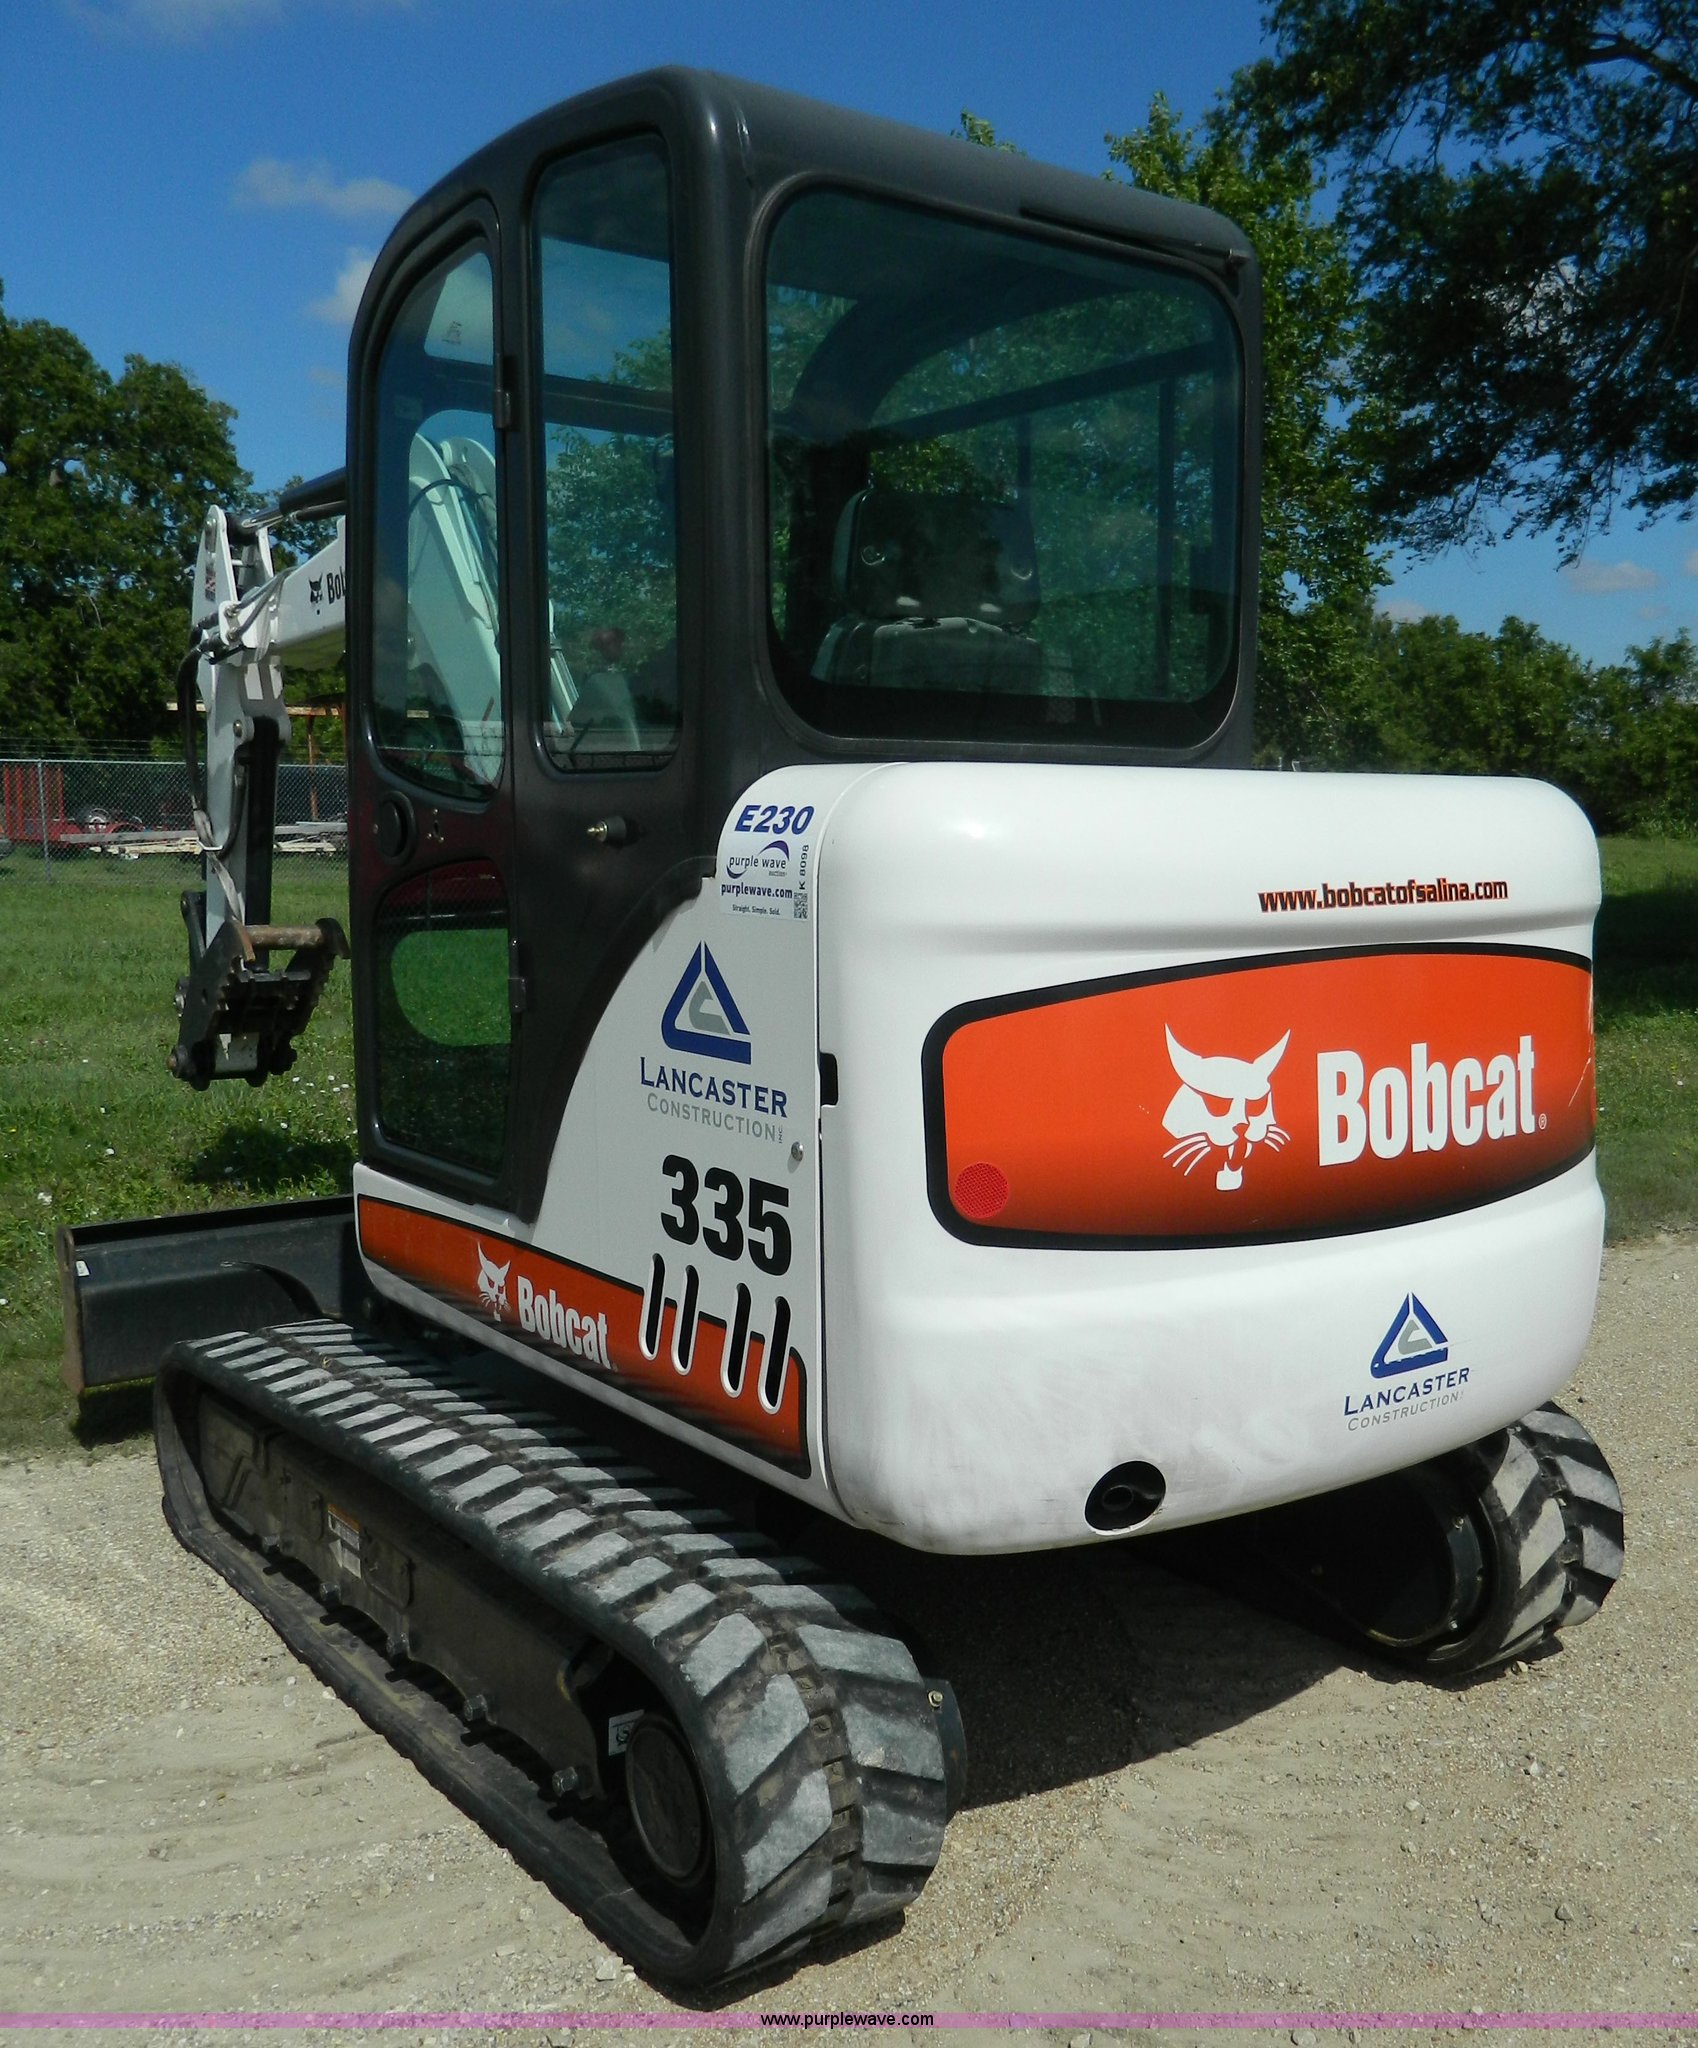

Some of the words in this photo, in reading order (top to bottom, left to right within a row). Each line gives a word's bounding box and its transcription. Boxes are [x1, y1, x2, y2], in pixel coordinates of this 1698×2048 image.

[735, 805, 814, 834] E230
[729, 855, 759, 869] purple
[762, 859, 786, 869] wave
[721, 881, 793, 899] purplewave.com
[1258, 877, 1508, 913] www.bobcatofsalina.com
[640, 1056, 788, 1118] LANCASTER
[1316, 1034, 1536, 1167] Bobcat
[647, 1092, 776, 1142] CONSTRUCTION
[660, 1154, 792, 1276] 335
[517, 1275, 612, 1370] Bobcat
[1344, 1367, 1470, 1416] LANCASTER
[1347, 1394, 1459, 1432] CONSTRUCTION
